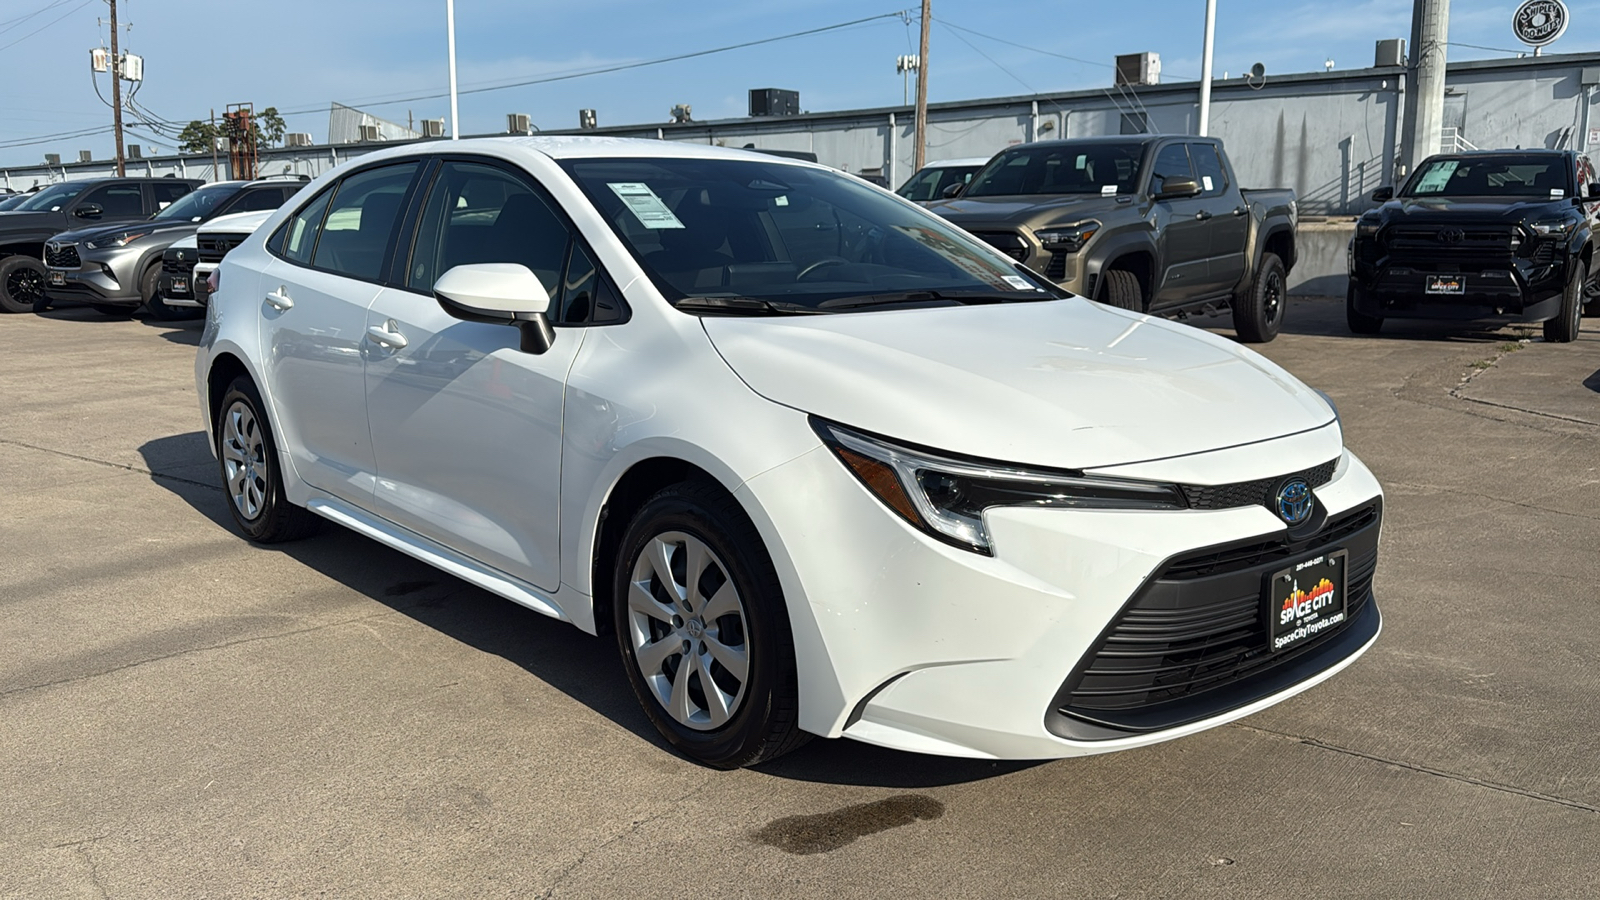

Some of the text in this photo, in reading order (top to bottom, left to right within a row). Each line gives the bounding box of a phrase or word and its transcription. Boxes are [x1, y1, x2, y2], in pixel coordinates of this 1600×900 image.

[1520, 4, 1557, 21] SHIPLEY
[1280, 590, 1334, 625] SPACE CITY
[1275, 613, 1344, 648] SpaceCityToyota.com
